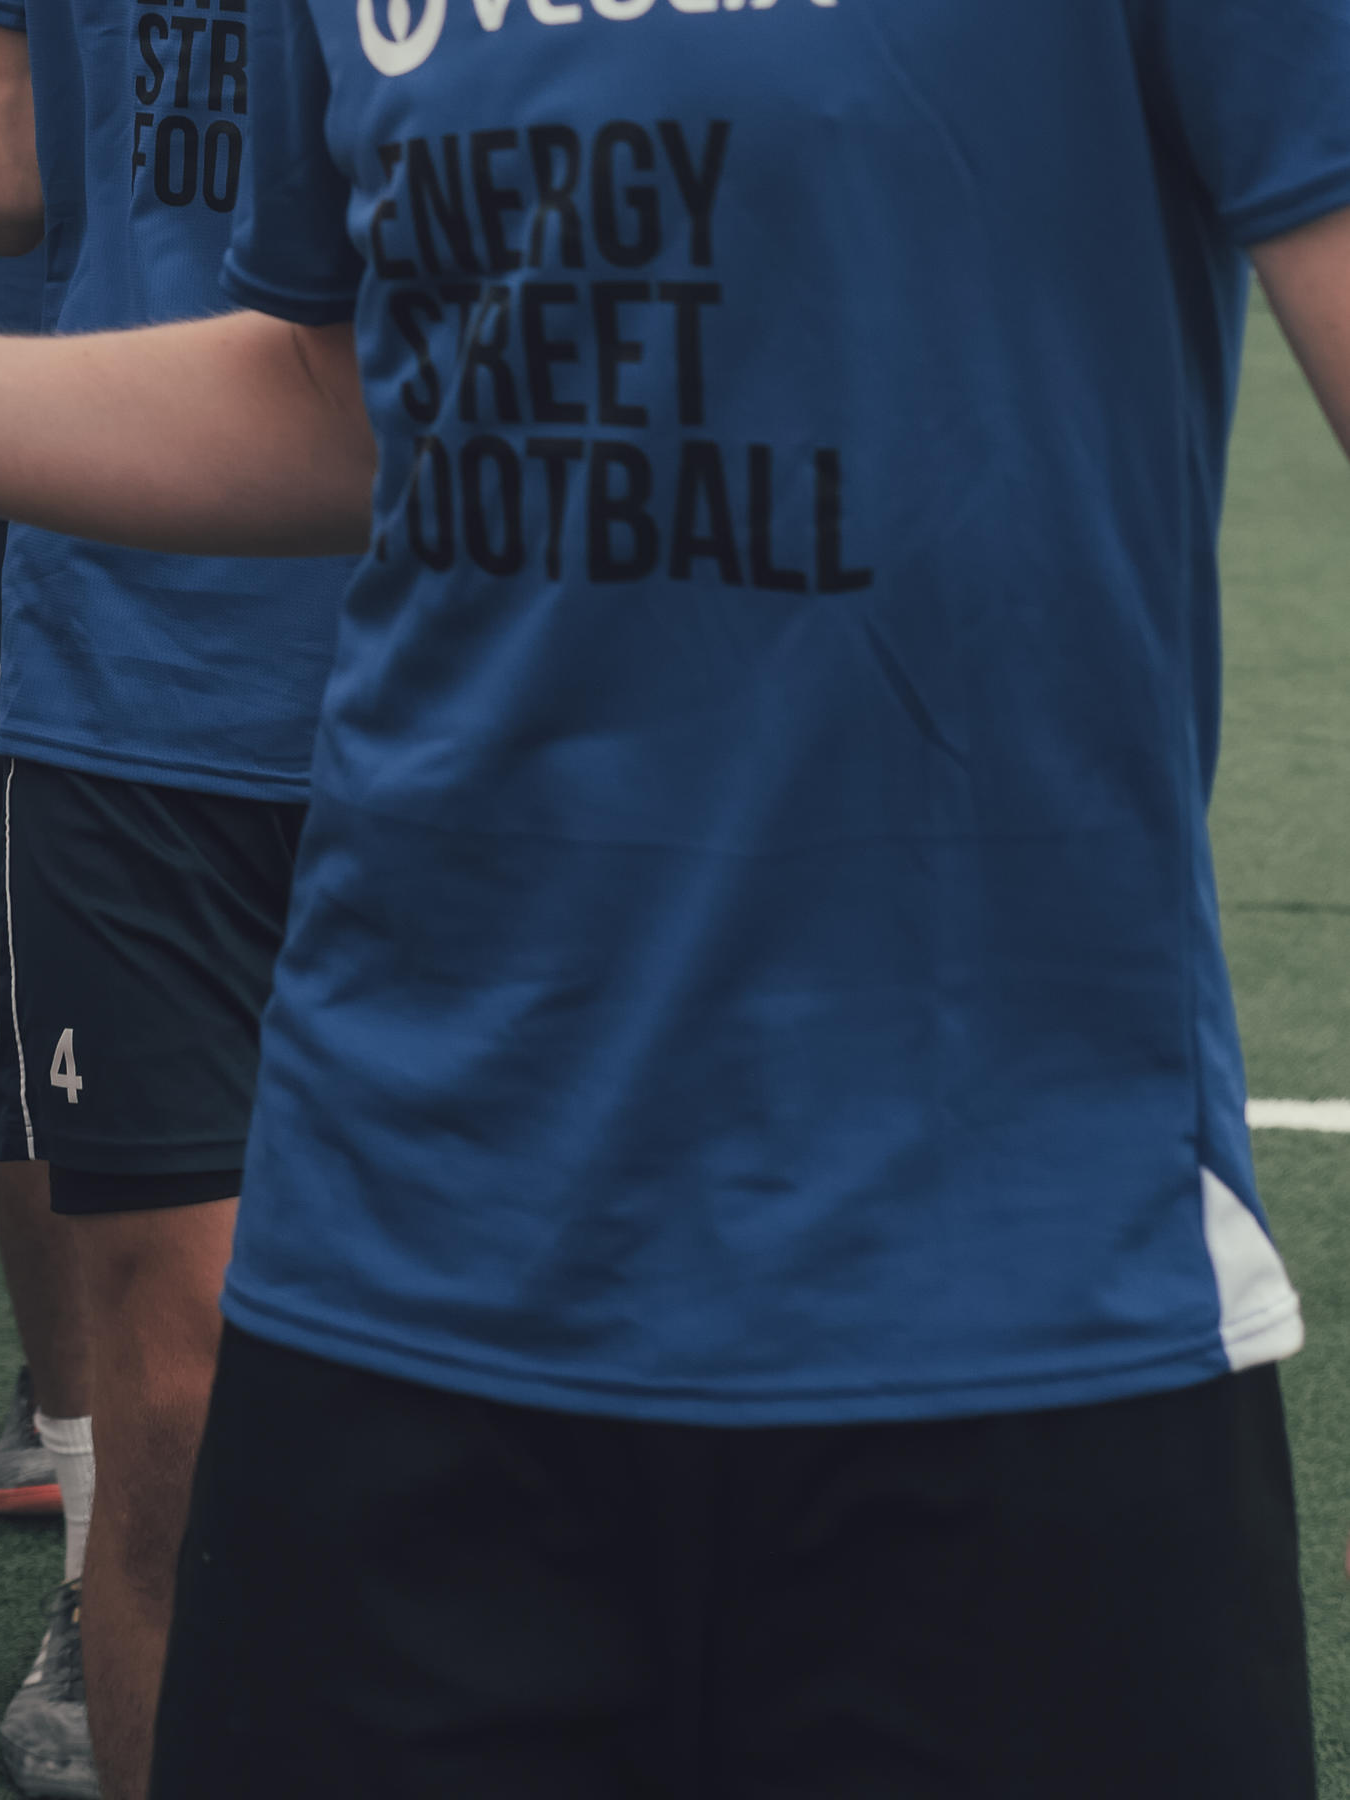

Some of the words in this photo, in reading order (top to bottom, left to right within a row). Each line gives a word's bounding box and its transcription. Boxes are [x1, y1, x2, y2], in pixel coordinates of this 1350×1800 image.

[135, 12, 248, 115] STR
[369, 119, 733, 281] ENERGY
[374, 434, 876, 595] OOTBALL
[50, 1027, 83, 1104] 4
